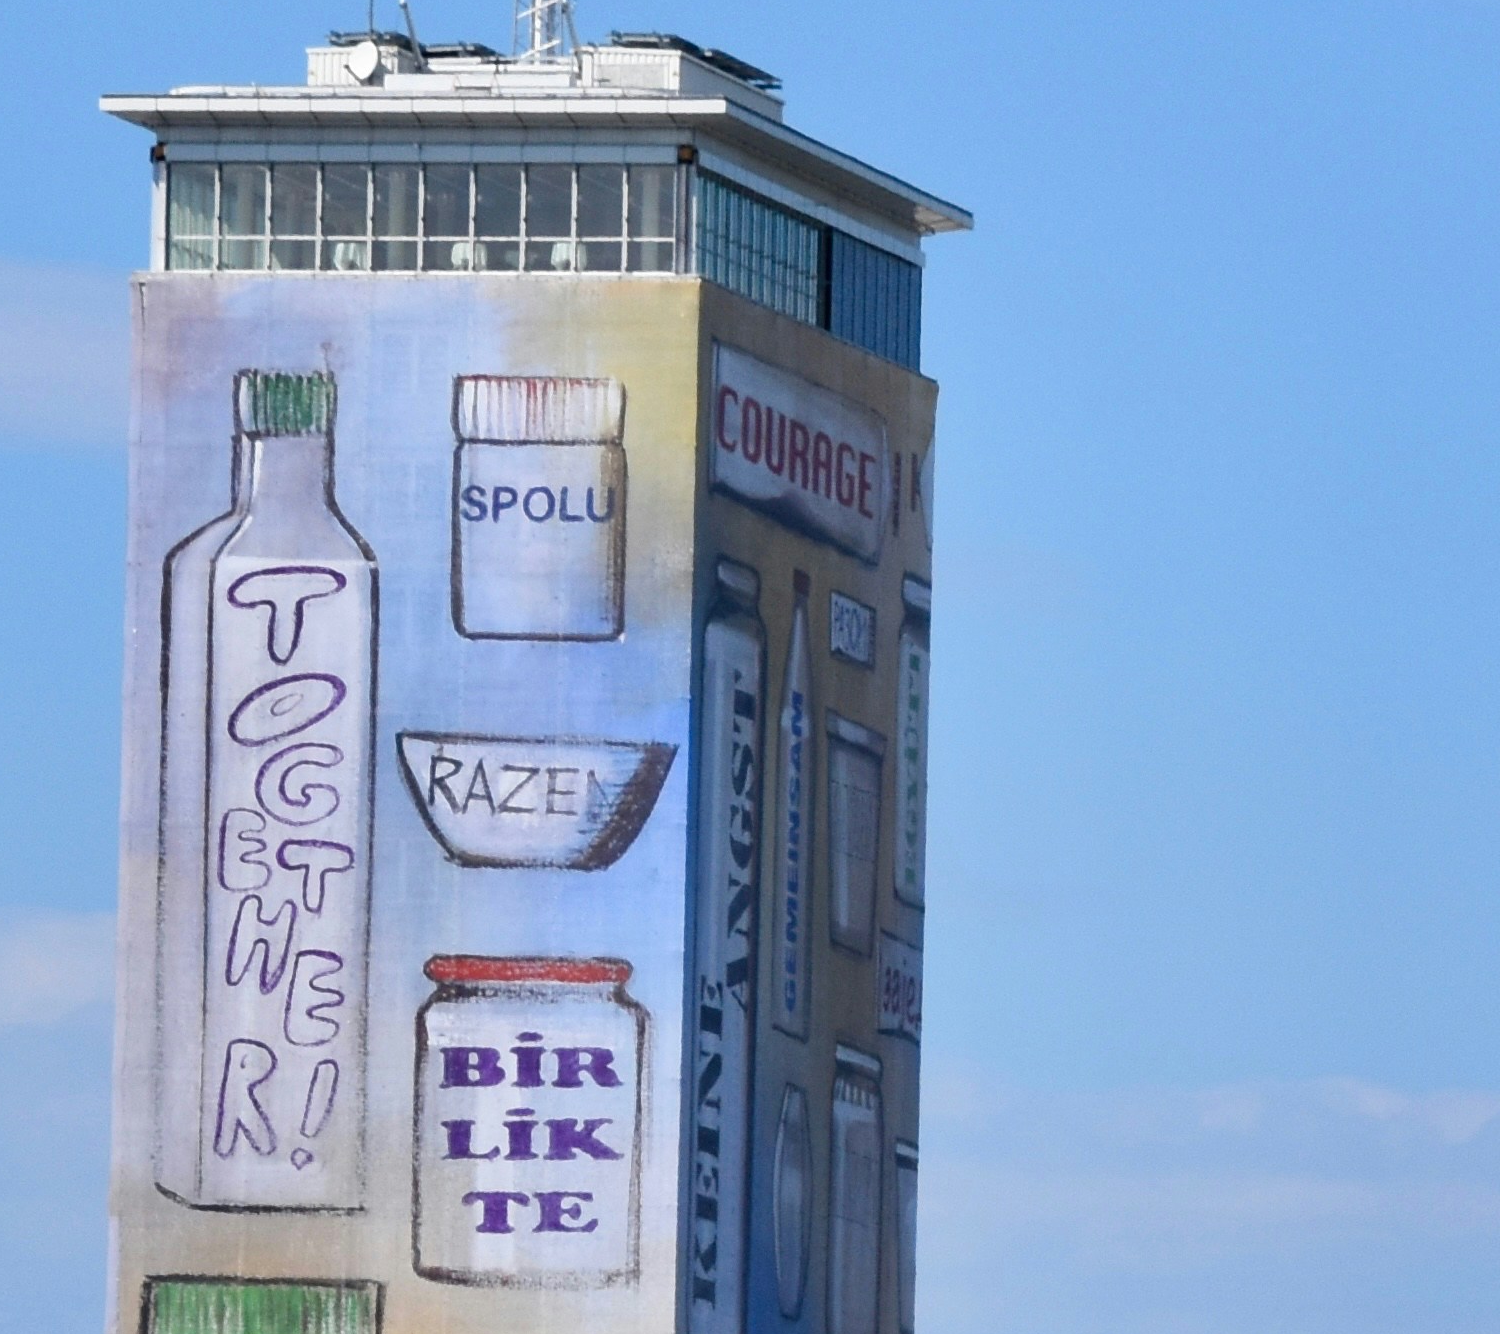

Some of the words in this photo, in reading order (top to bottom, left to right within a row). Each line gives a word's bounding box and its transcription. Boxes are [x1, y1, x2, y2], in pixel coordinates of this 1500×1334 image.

[716, 385, 877, 519] COURAGE
[459, 486, 616, 523] SPOLU
[724, 670, 759, 1019] ANGST
[782, 690, 805, 1013] GEMEINSAM
[439, 1032, 623, 1090] BİR
[440, 1107, 624, 1162] LİK
[692, 973, 724, 1309] KEINE
[464, 1190, 599, 1234] TE
